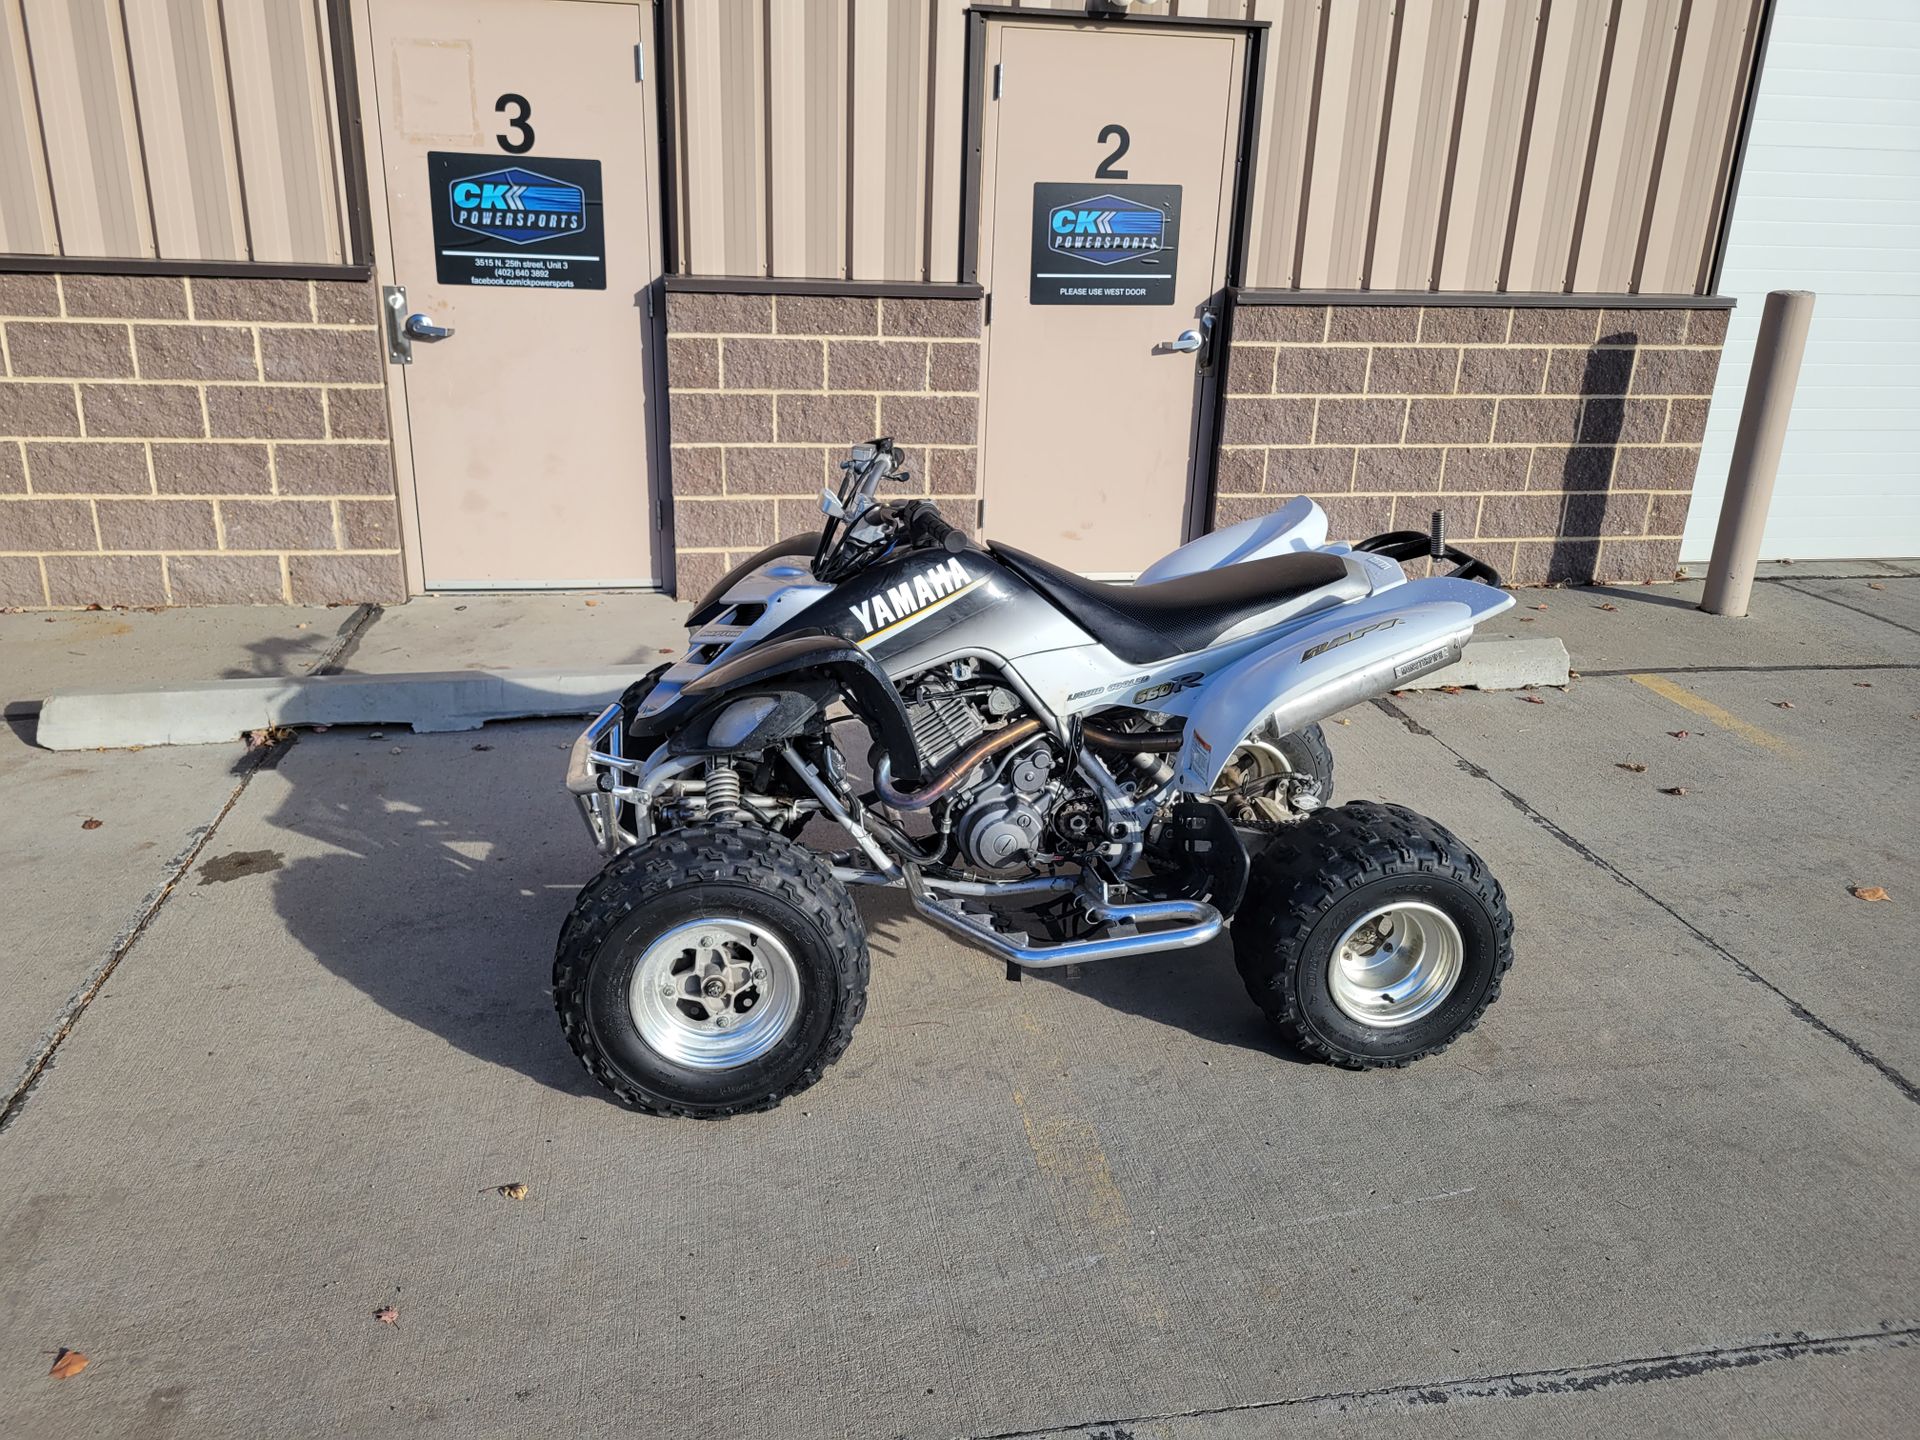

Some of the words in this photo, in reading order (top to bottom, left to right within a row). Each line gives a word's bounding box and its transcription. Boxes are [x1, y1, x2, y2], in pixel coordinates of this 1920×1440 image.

[495, 93, 535, 154] 3
[1095, 124, 1130, 179] 2
[453, 182, 509, 210] CK
[459, 210, 579, 229] POWERSPORTS
[1052, 210, 1102, 234] CK
[1055, 235, 1158, 249] POWERSPORTS
[475, 258, 494, 267] 3515
[495, 259, 503, 267] N.
[505, 259, 521, 268] 25th
[522, 260, 545, 270] street,
[546, 261, 562, 269] Unit
[563, 262, 568, 270] 3
[494, 268, 515, 277] (402)
[515, 269, 529, 277] 640
[530, 270, 549, 278] 3892
[471, 276, 575, 288] facebook.com/ckpowersports
[1060, 288, 1087, 296] PLEASE
[1088, 288, 1103, 296] USE
[1104, 288, 1124, 296] WEST
[1125, 288, 1146, 296] DOOR
[849, 556, 972, 634] YAMAHA
[1106, 675, 1151, 692] COOLED
